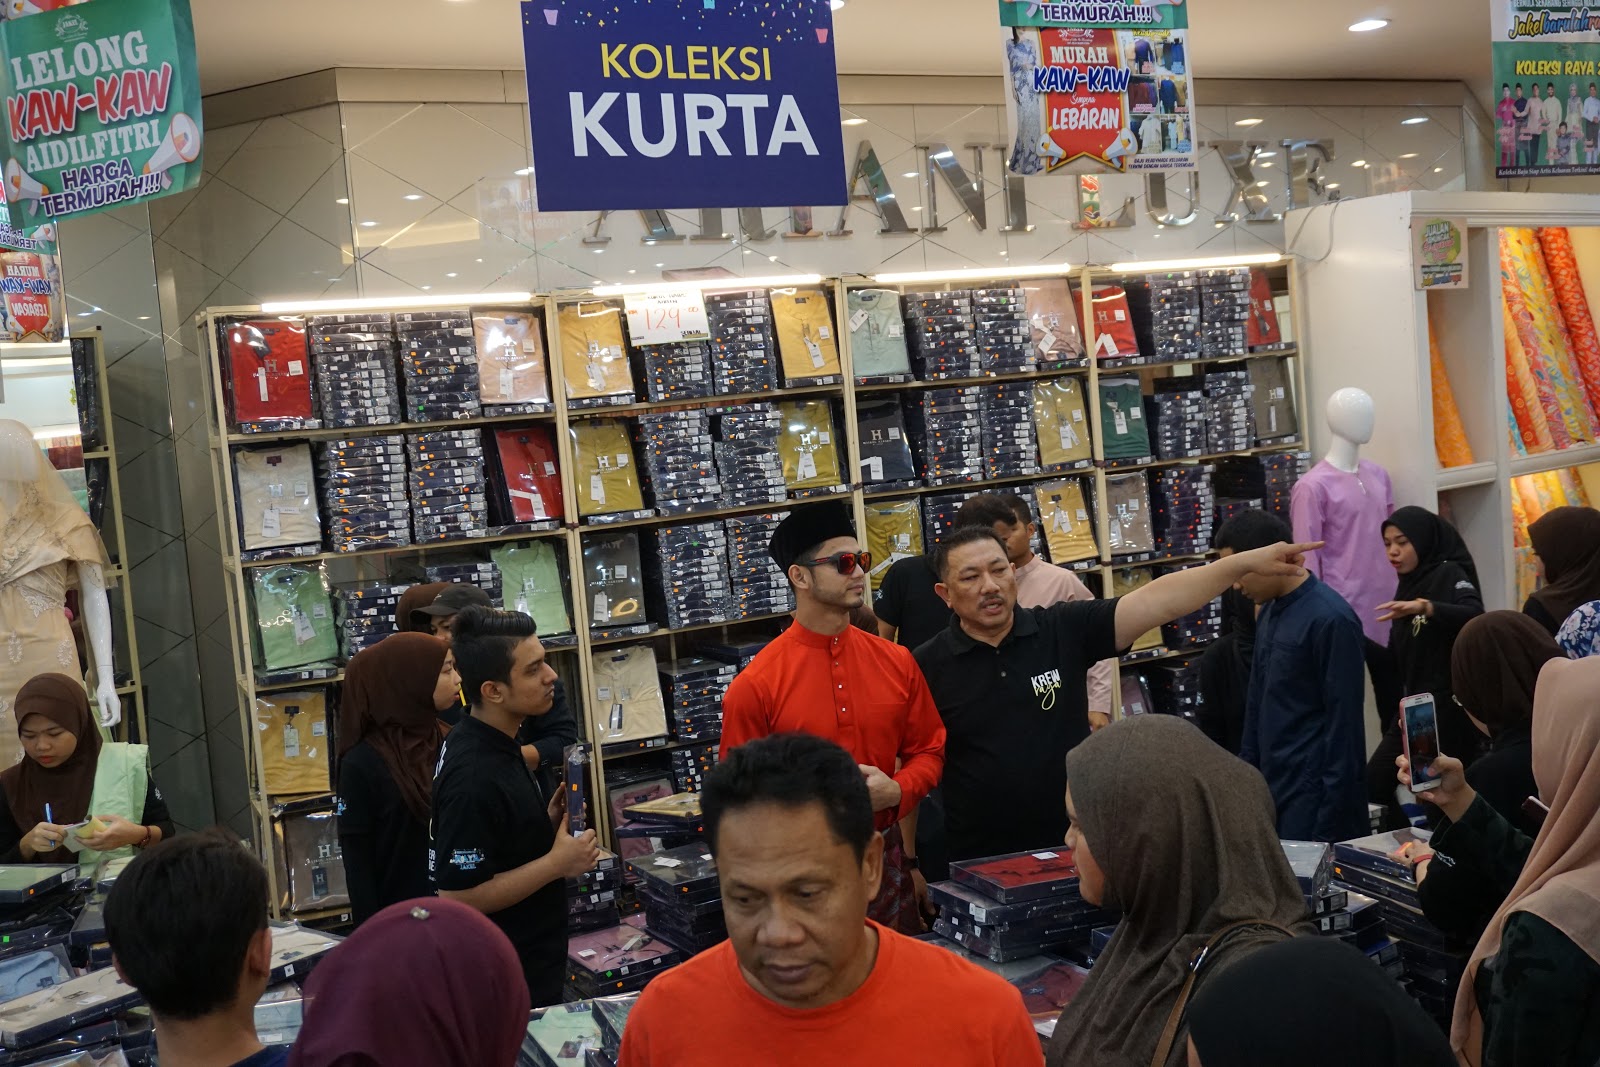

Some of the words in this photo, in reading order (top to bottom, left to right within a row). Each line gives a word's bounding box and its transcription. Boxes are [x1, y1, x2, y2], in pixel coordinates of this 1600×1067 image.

[1041, 5, 1152, 22] TERMURAH!!!
[11, 30, 148, 90] LELONG
[600, 42, 773, 81] KOLEKSI
[1050, 46, 1109, 64] MURAH
[1515, 60, 1561, 75] KOLEKSI
[1564, 60, 1595, 75] RAYA
[1033, 67, 1130, 92] KAW-KAW
[7, 61, 172, 143] KAW-KAW
[569, 91, 820, 159] KURTA
[1052, 107, 1120, 130] LEBARAN
[27, 119, 161, 173] AIDILFITRI
[61, 157, 133, 190] HARGA
[41, 172, 161, 217] TERMURAH!!!
[645, 307, 681, 330] 129
[871, 429, 883, 441] H
[597, 455, 610, 468] H
[1031, 669, 1061, 689] KREW
[318, 844, 331, 858] H
